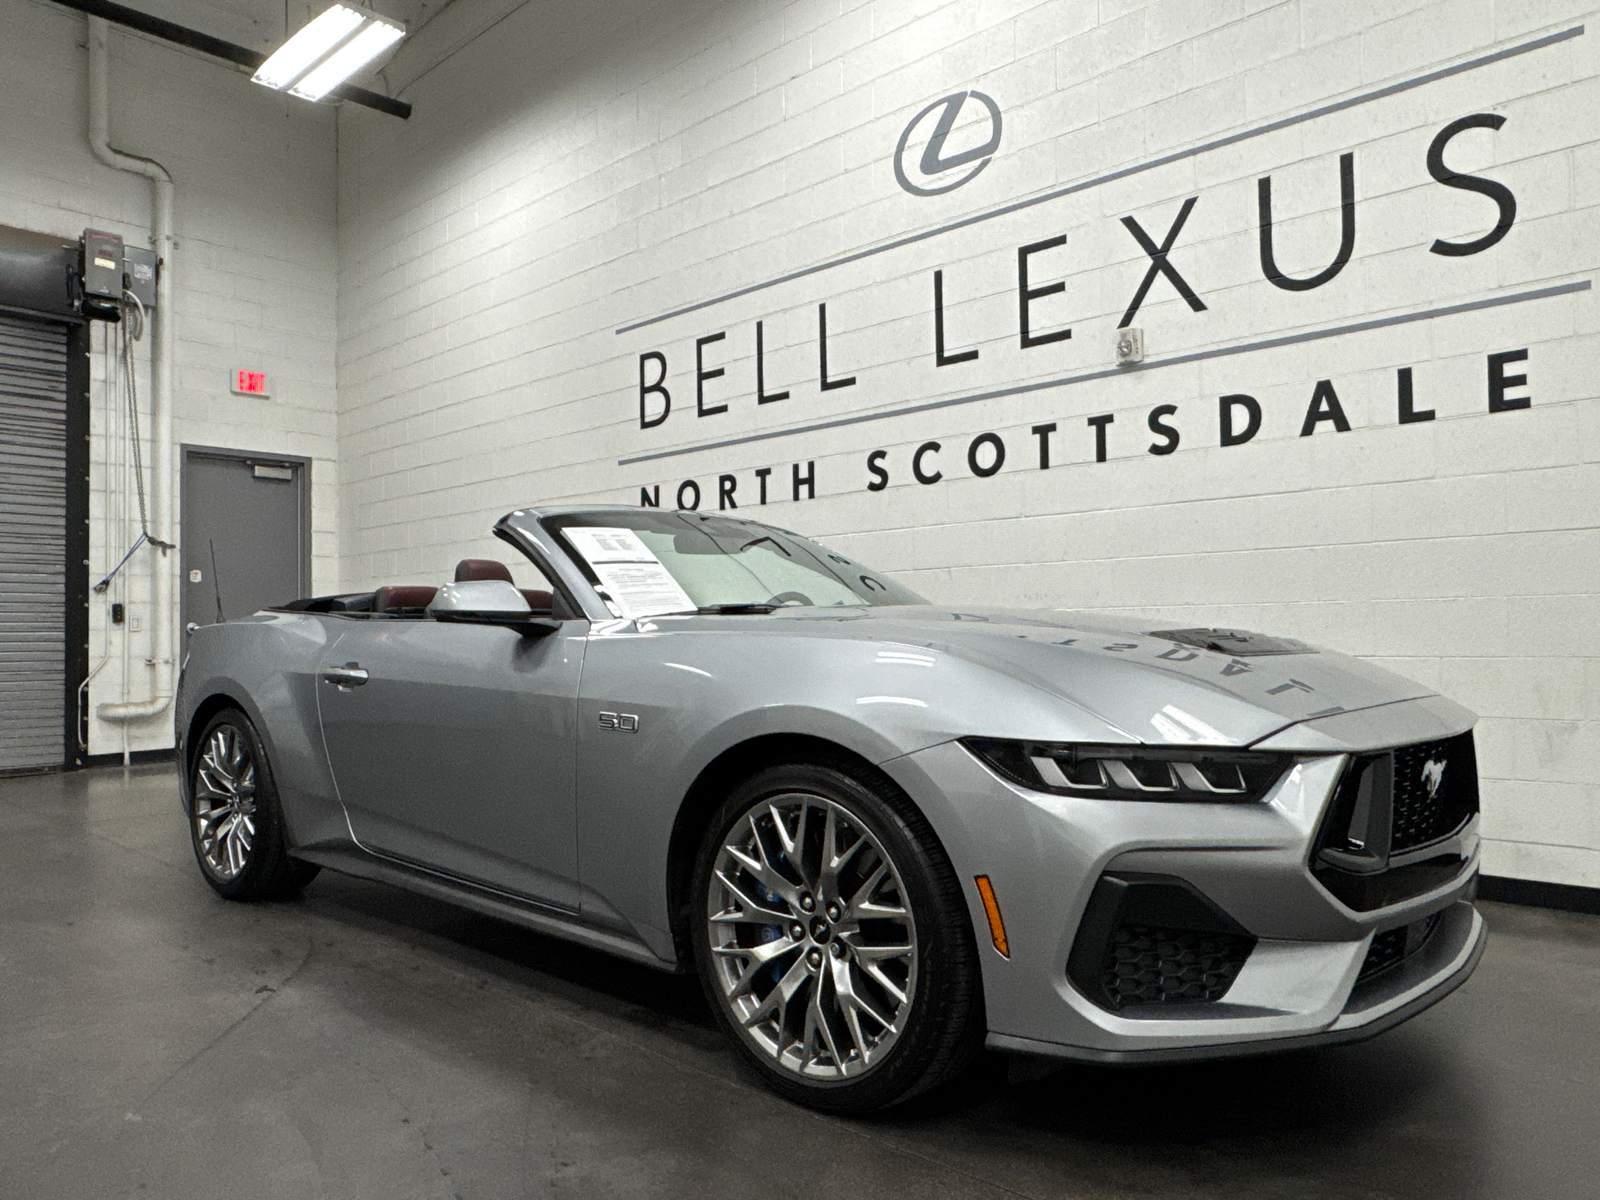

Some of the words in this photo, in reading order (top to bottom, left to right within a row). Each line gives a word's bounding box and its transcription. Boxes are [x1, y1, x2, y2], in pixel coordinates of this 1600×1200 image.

[639, 303, 856, 430] BELL
[934, 113, 1517, 367] LEXUS
[238, 370, 266, 394] EXIT
[640, 460, 815, 511] NORTH
[867, 348, 1531, 492] SCOTTSDALE
